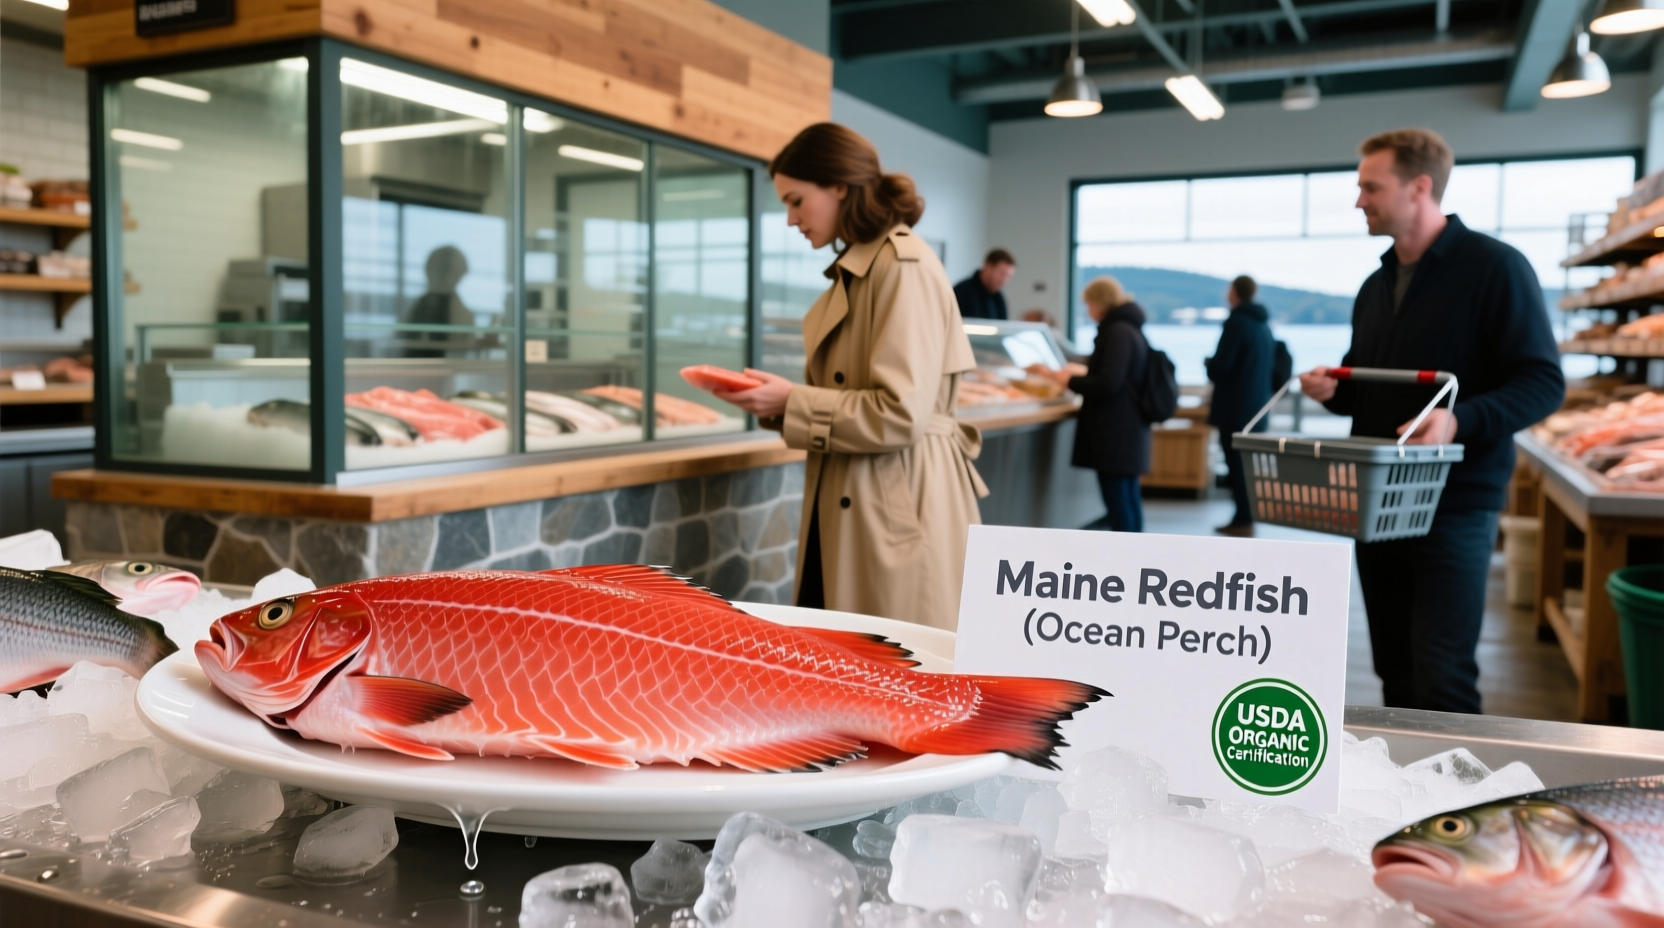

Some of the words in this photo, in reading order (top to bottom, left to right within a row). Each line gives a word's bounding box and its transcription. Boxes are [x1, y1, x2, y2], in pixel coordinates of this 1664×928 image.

[997, 559, 1125, 604] Maine
[1138, 567, 1309, 616] Redfish
[1023, 607, 1145, 649] (Ocean
[1157, 620, 1272, 665] Perch)
[1228, 725, 1310, 752] ORGANIC
[1237, 702, 1307, 732] USDA
